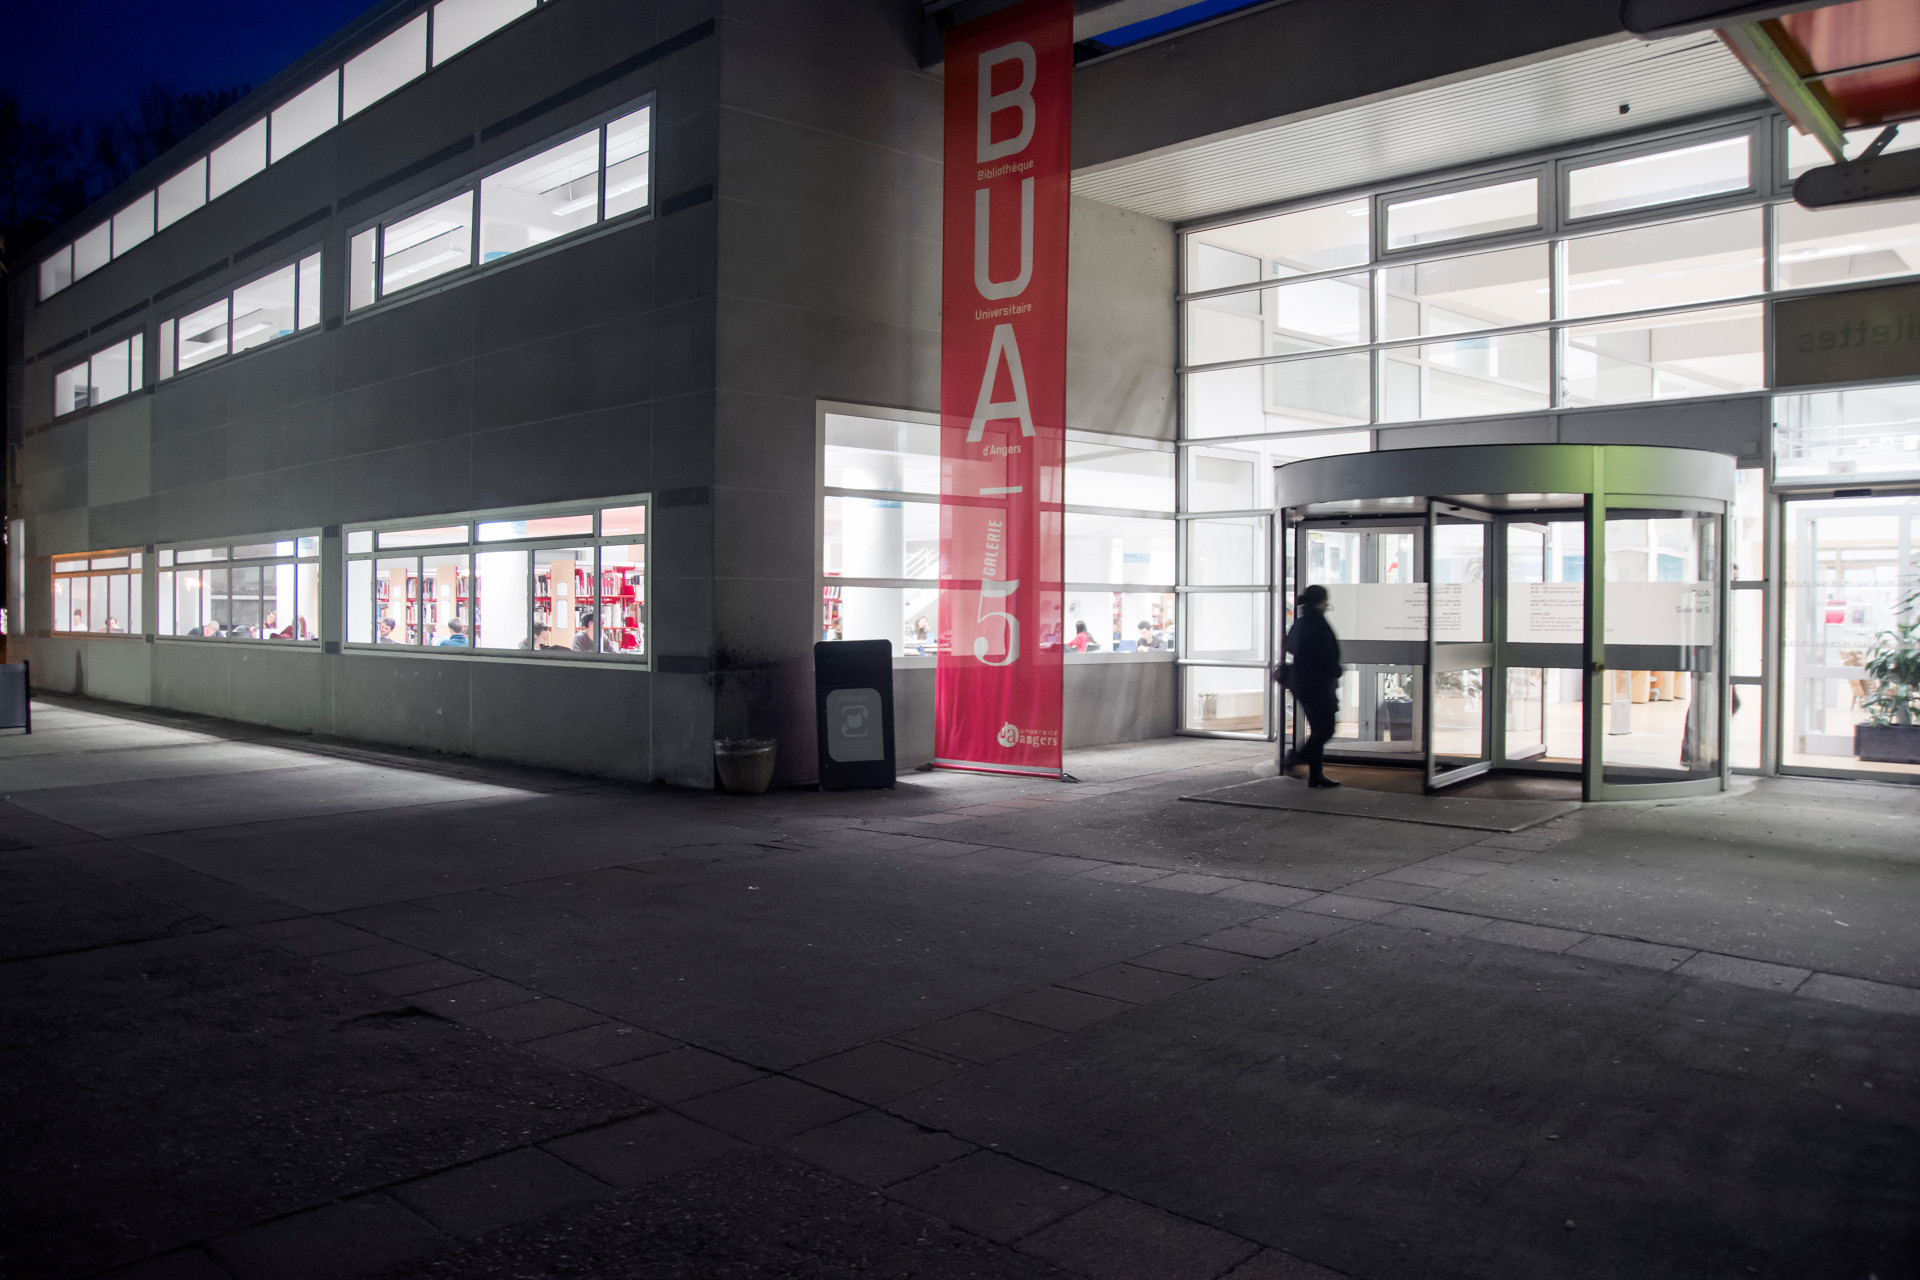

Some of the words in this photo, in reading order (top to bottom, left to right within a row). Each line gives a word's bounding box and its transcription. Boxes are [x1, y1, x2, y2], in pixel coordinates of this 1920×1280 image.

[976, 40, 1037, 164] B
[977, 160, 1034, 181] Bibliothèque
[974, 176, 1035, 301] U
[975, 302, 1032, 321] Universitaire
[966, 323, 1036, 443] A
[983, 444, 1022, 457] d'Angers
[983, 519, 1003, 577] GALERIE
[973, 578, 1020, 667] 5
[1019, 735, 1058, 748] angers
